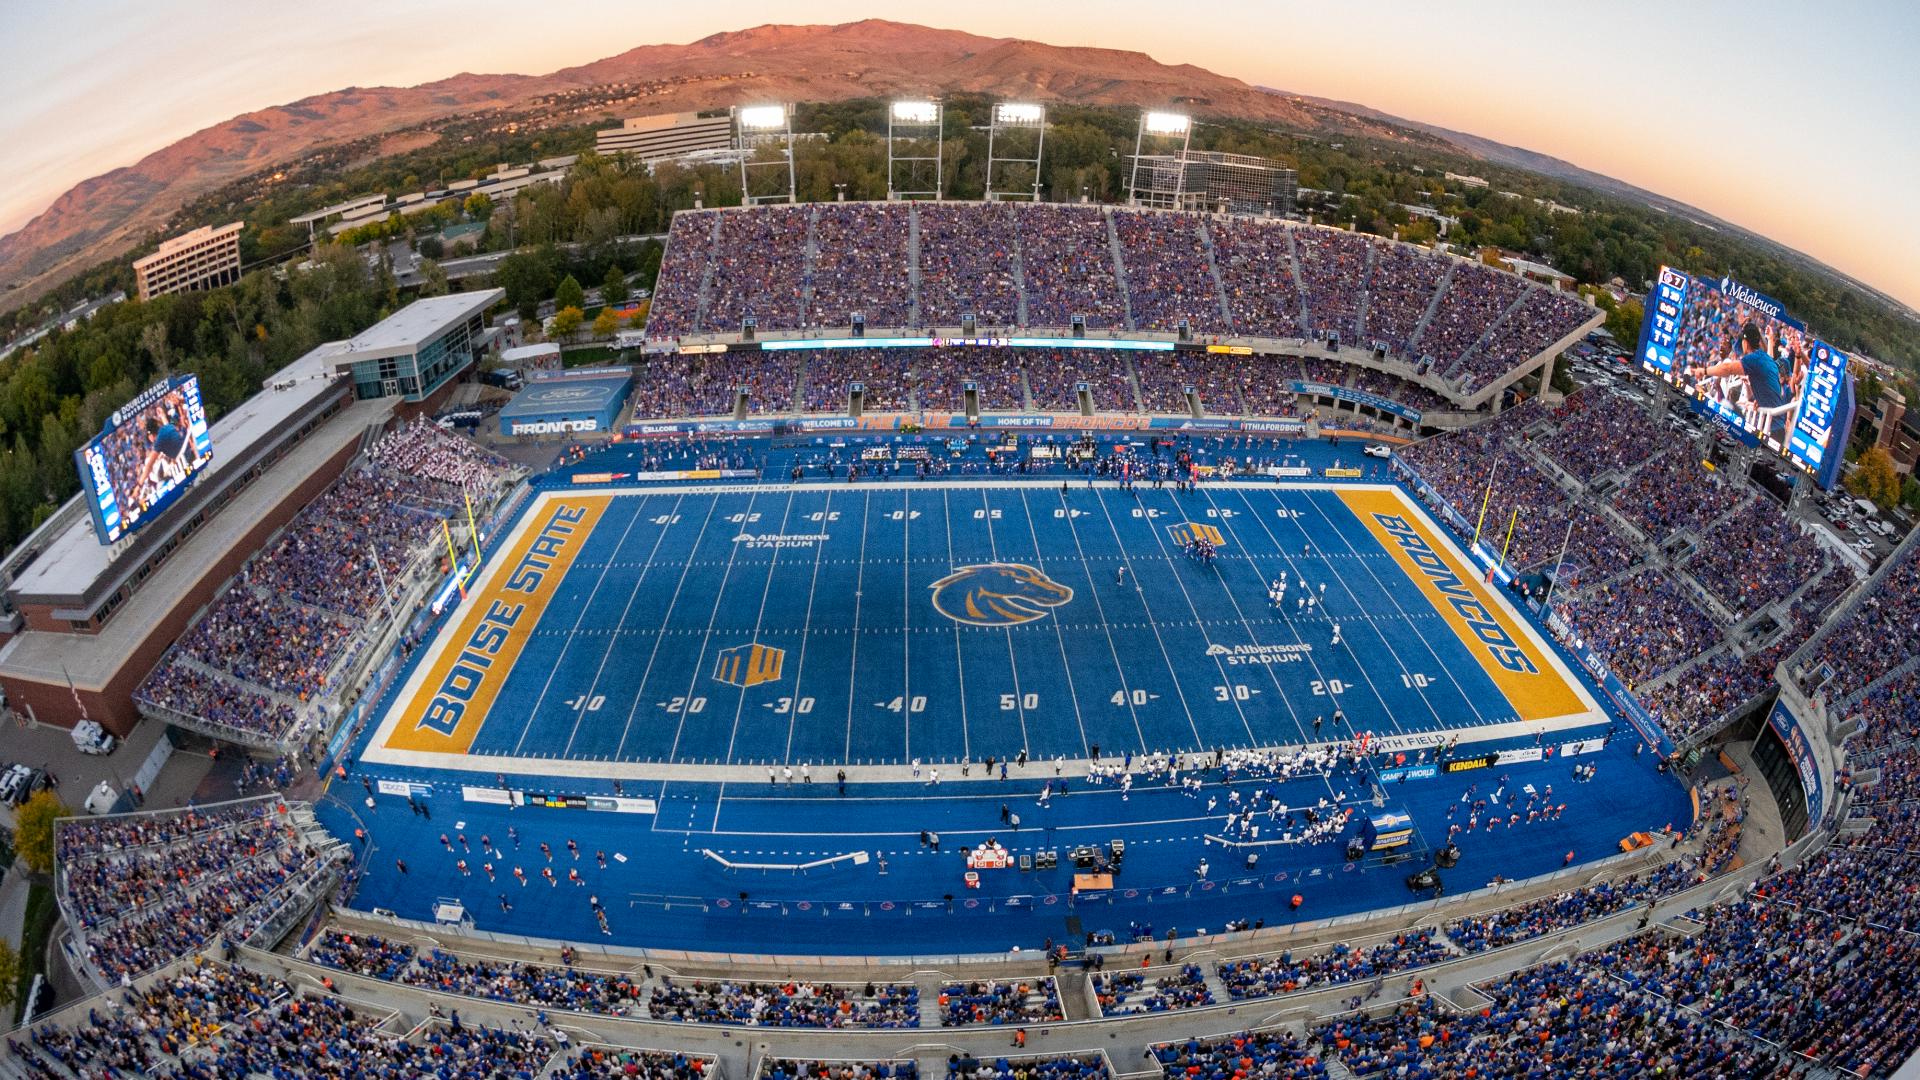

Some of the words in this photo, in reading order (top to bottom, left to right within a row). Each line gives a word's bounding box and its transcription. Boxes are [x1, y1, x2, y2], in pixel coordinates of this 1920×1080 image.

[1728, 282, 1778, 318] Melaleuca
[121, 394, 144, 415] DOUBLE
[148, 378, 169, 396] RANCH
[512, 419, 597, 435] BRONCOS
[802, 420, 842, 428] WELCOME
[843, 419, 855, 427] TO
[998, 418, 1021, 426] HOME
[1022, 418, 1034, 426] OF
[1035, 418, 1050, 426] THE
[1052, 416, 1151, 429] BRONCOS
[1711, 413, 1731, 432] Ford
[655, 514, 682, 525] 10
[732, 513, 762, 523] 20
[811, 511, 841, 521] 30
[892, 510, 922, 520] 40
[973, 510, 1002, 519] 50
[1054, 509, 1081, 518] 40
[1132, 508, 1160, 518] 30
[1206, 508, 1234, 518] 20
[1277, 508, 1300, 518] 10
[746, 540, 813, 549] STADIUM
[756, 533, 830, 542] Albertsons
[1369, 512, 1540, 675] BRONCOS
[414, 599, 526, 738] BOISE
[501, 504, 588, 594] STATE
[1233, 643, 1312, 654] Albertsons
[1227, 652, 1303, 665] STADIUM
[1310, 679, 1344, 696] 20
[1401, 673, 1429, 688] 10
[1110, 689, 1147, 706] 40
[1214, 685, 1250, 701] 30
[572, 695, 606, 711] 10
[666, 697, 707, 713] 20
[773, 697, 816, 713] 30
[887, 695, 927, 713] 40
[1000, 693, 1039, 710] 50
[1407, 734, 1446, 748] FIELD
[1449, 758, 1487, 772] KENDALL
[1411, 768, 1435, 778] WORLD
